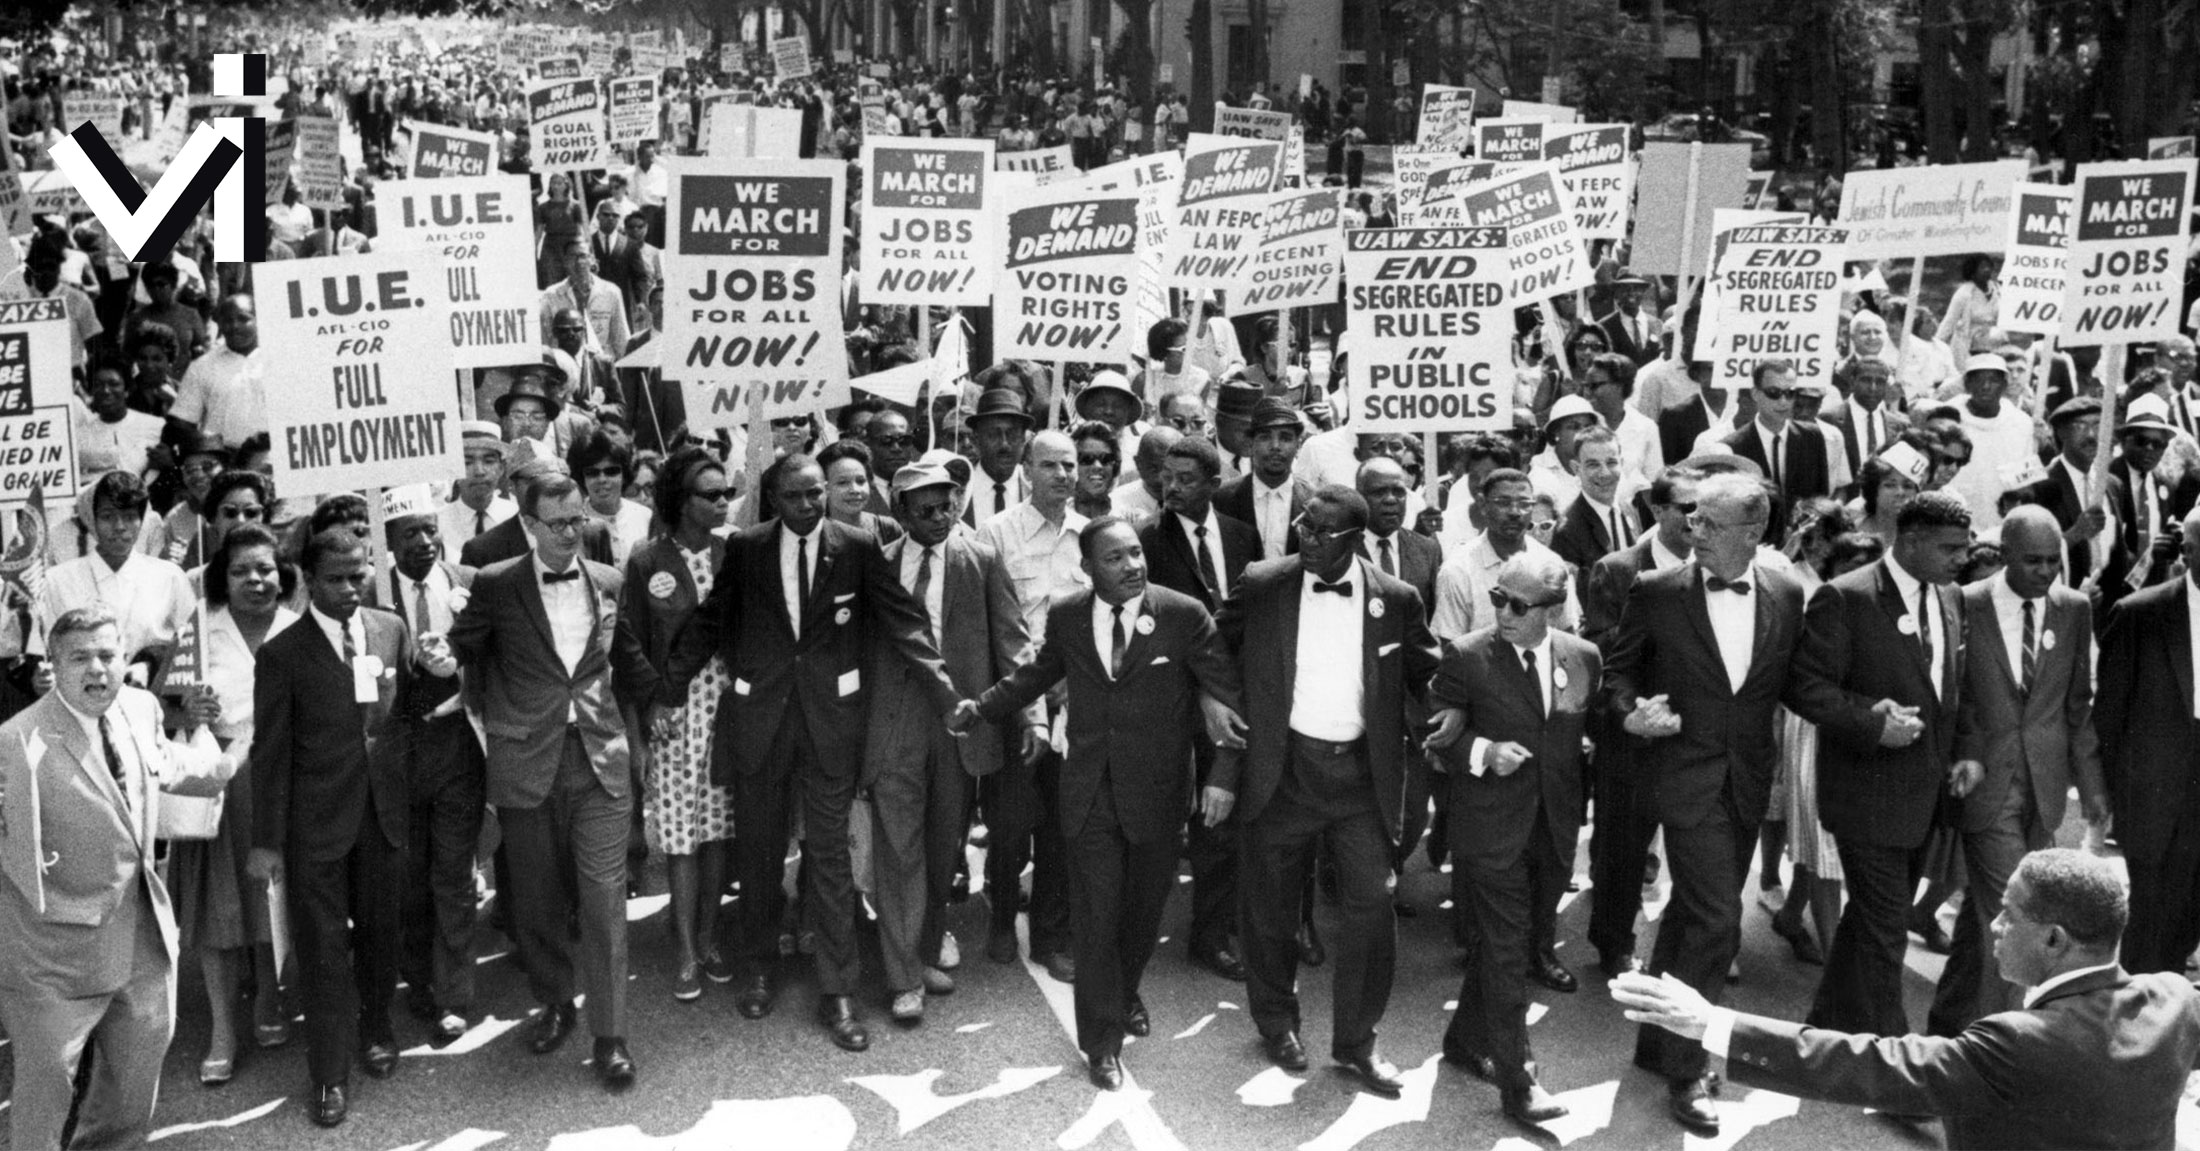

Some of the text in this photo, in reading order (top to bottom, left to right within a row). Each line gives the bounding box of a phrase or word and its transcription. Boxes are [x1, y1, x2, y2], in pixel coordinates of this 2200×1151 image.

[543, 67, 578, 77] MARCH
[550, 82, 575, 102] WE
[616, 89, 652, 100] MARCH
[1439, 91, 1459, 102] WE
[534, 92, 596, 120] DEMAND
[1223, 112, 1252, 124] UAW
[543, 122, 594, 136] EQUAL
[616, 126, 652, 139] NOW!
[1504, 126, 1523, 138] WE
[446, 138, 470, 155] WE
[544, 135, 598, 149] RIGHTS
[1485, 137, 1540, 153] MARCH
[1568, 131, 1600, 152] WE
[420, 151, 485, 176] MARCH
[544, 148, 599, 166] NOW!
[913, 152, 946, 171] WE
[1214, 148, 1251, 174] WE
[1501, 152, 1524, 161] FOR
[1560, 143, 1622, 171] EMAND
[880, 171, 976, 194] MARCH
[1184, 166, 1270, 201] DEMAND
[1447, 166, 1475, 183] WE
[1562, 177, 1622, 192] N FEPC
[735, 182, 779, 203] WE
[1494, 182, 1523, 202] WE
[2122, 178, 2152, 197] WE
[402, 192, 514, 228] I.U.E.
[909, 194, 947, 206] FOR
[1265, 197, 1307, 223] WE
[1476, 189, 1554, 226] MARCH
[1575, 195, 1608, 209] AW
[2056, 199, 2072, 215] W
[2087, 196, 2178, 224] MARCH
[691, 206, 820, 234] MARCH
[1050, 203, 1100, 231] WE
[1179, 208, 1263, 230] AN FEPC
[1420, 206, 1461, 220] AN FE
[1574, 210, 1619, 229] OW!
[425, 231, 486, 243] AFL-CIO
[879, 217, 973, 243] JOBS
[1354, 228, 1504, 250] UAW SAYS:
[1511, 219, 1568, 249] GRATED
[1735, 228, 1847, 243] UAW SAYS:
[2114, 223, 2148, 236] FOR
[730, 238, 780, 251] FOR
[1014, 223, 1134, 261] DEMAND
[1193, 231, 1243, 251] LAW
[2050, 235, 2069, 247] FO
[443, 244, 480, 260] FOR
[881, 247, 969, 260] FOR ALL
[1509, 239, 1574, 271] HOOLS
[1745, 248, 1822, 268] END
[2012, 254, 2068, 270] JOBS FO
[1173, 253, 1248, 278] NOW!
[1252, 262, 1334, 284] OUSING
[1374, 255, 1478, 281] END
[2082, 247, 2170, 279] JOBS
[447, 266, 481, 303] ULL
[688, 268, 817, 302] JOBS
[876, 265, 976, 293] NOW!
[1016, 270, 1128, 296] VOTING
[1725, 270, 1838, 291] SEGREGATED
[2009, 275, 2066, 292] A DECEN
[2083, 280, 2164, 297] FOR ALL
[287, 270, 425, 319] I.U.E.
[1244, 276, 1329, 306] NOW!
[1352, 282, 1504, 311] SEGREGATED
[0, 301, 60, 322] AYS:
[1021, 296, 1121, 322] RIGHTS
[1739, 294, 1819, 313] RULES
[2014, 300, 2062, 322] NO
[692, 309, 811, 323] FOR ALL
[1374, 311, 1481, 338] RULES
[2075, 296, 2170, 333] NOW!
[316, 319, 391, 336] AFL-CIO
[450, 308, 528, 348] OYMENT
[1016, 321, 1122, 350] NOW!
[1761, 320, 1791, 331] IN
[336, 335, 385, 357] FOR
[686, 329, 821, 368] NOW!
[1407, 346, 1447, 360] IN
[1731, 333, 1821, 354] PUBLIC
[1370, 362, 1491, 389] PUBLIC
[1723, 357, 1822, 378] SCLS
[333, 362, 388, 410] FULL
[1364, 392, 1497, 421] SCHOOLS
[21, 420, 51, 440] BE
[286, 411, 447, 470] EMPLOYMENT
[39, 446, 63, 464] IN
